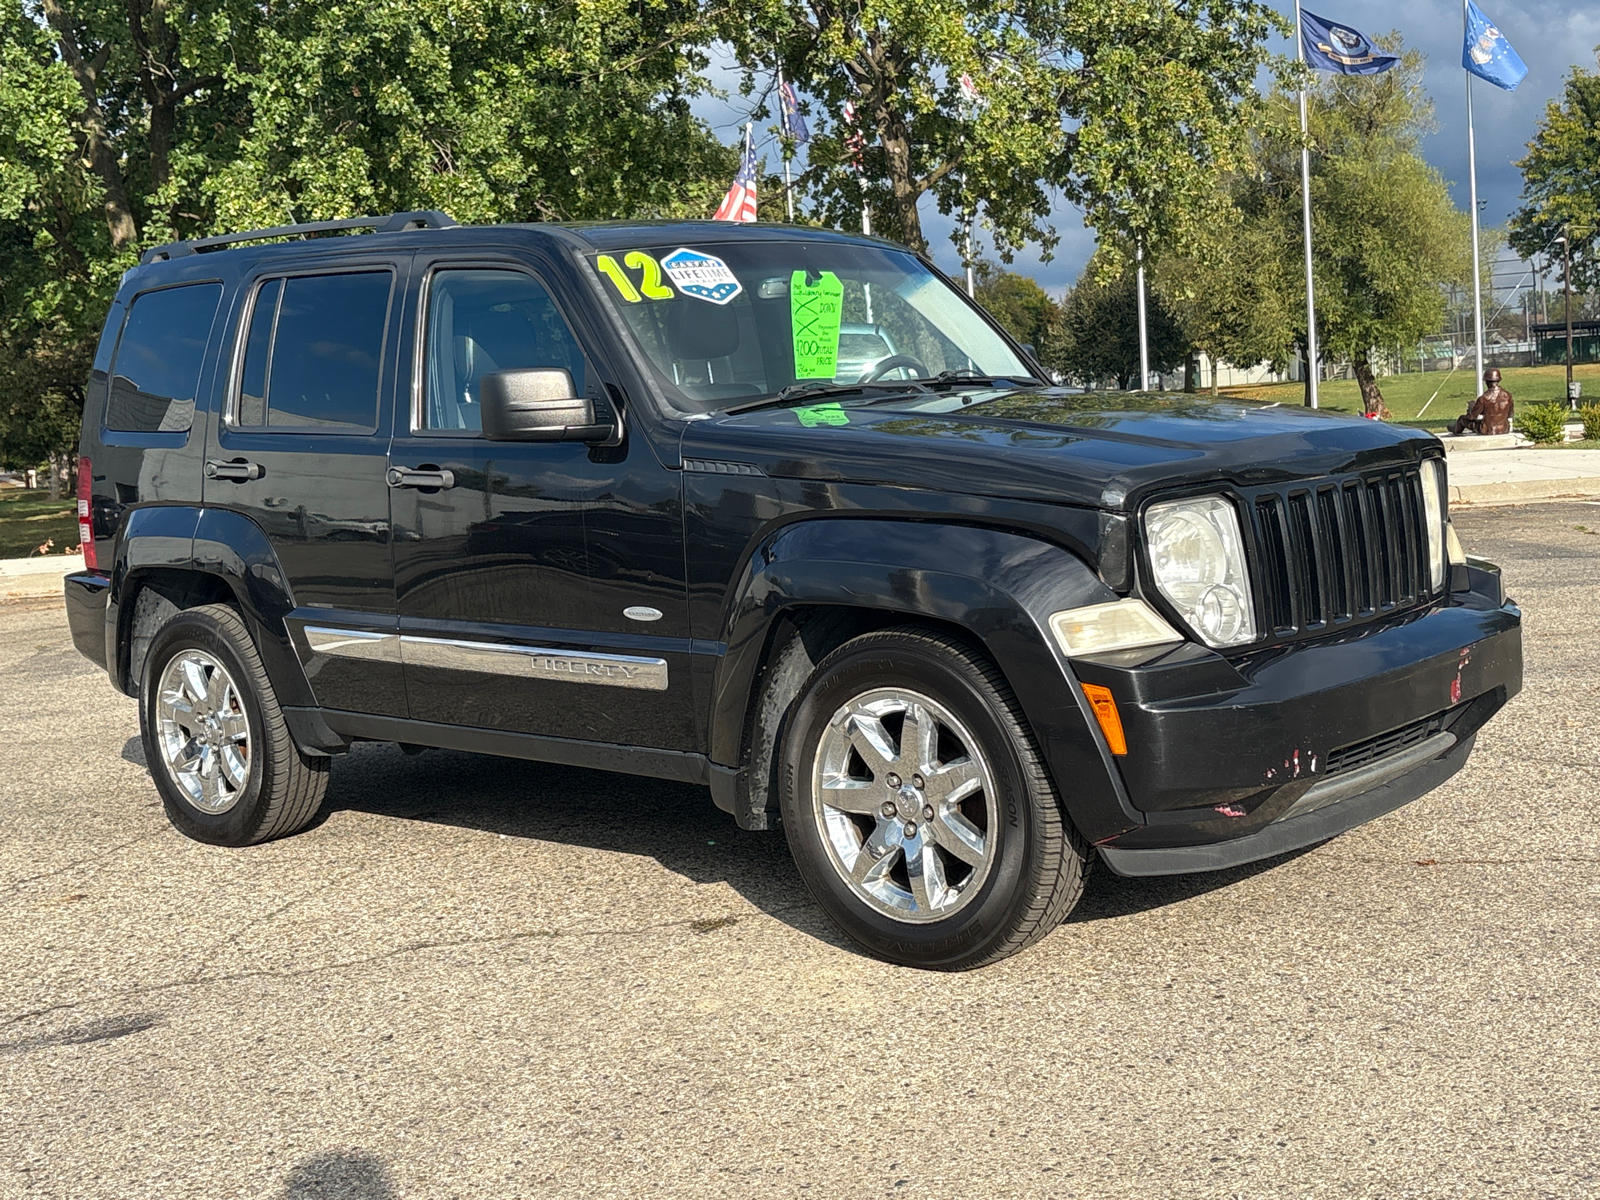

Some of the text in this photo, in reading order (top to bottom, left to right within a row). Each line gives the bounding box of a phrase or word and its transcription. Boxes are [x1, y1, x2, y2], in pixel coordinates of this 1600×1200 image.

[597, 251, 675, 303] 12
[670, 268, 731, 280] LIFETIME
[531, 657, 640, 678] LIBERTY
